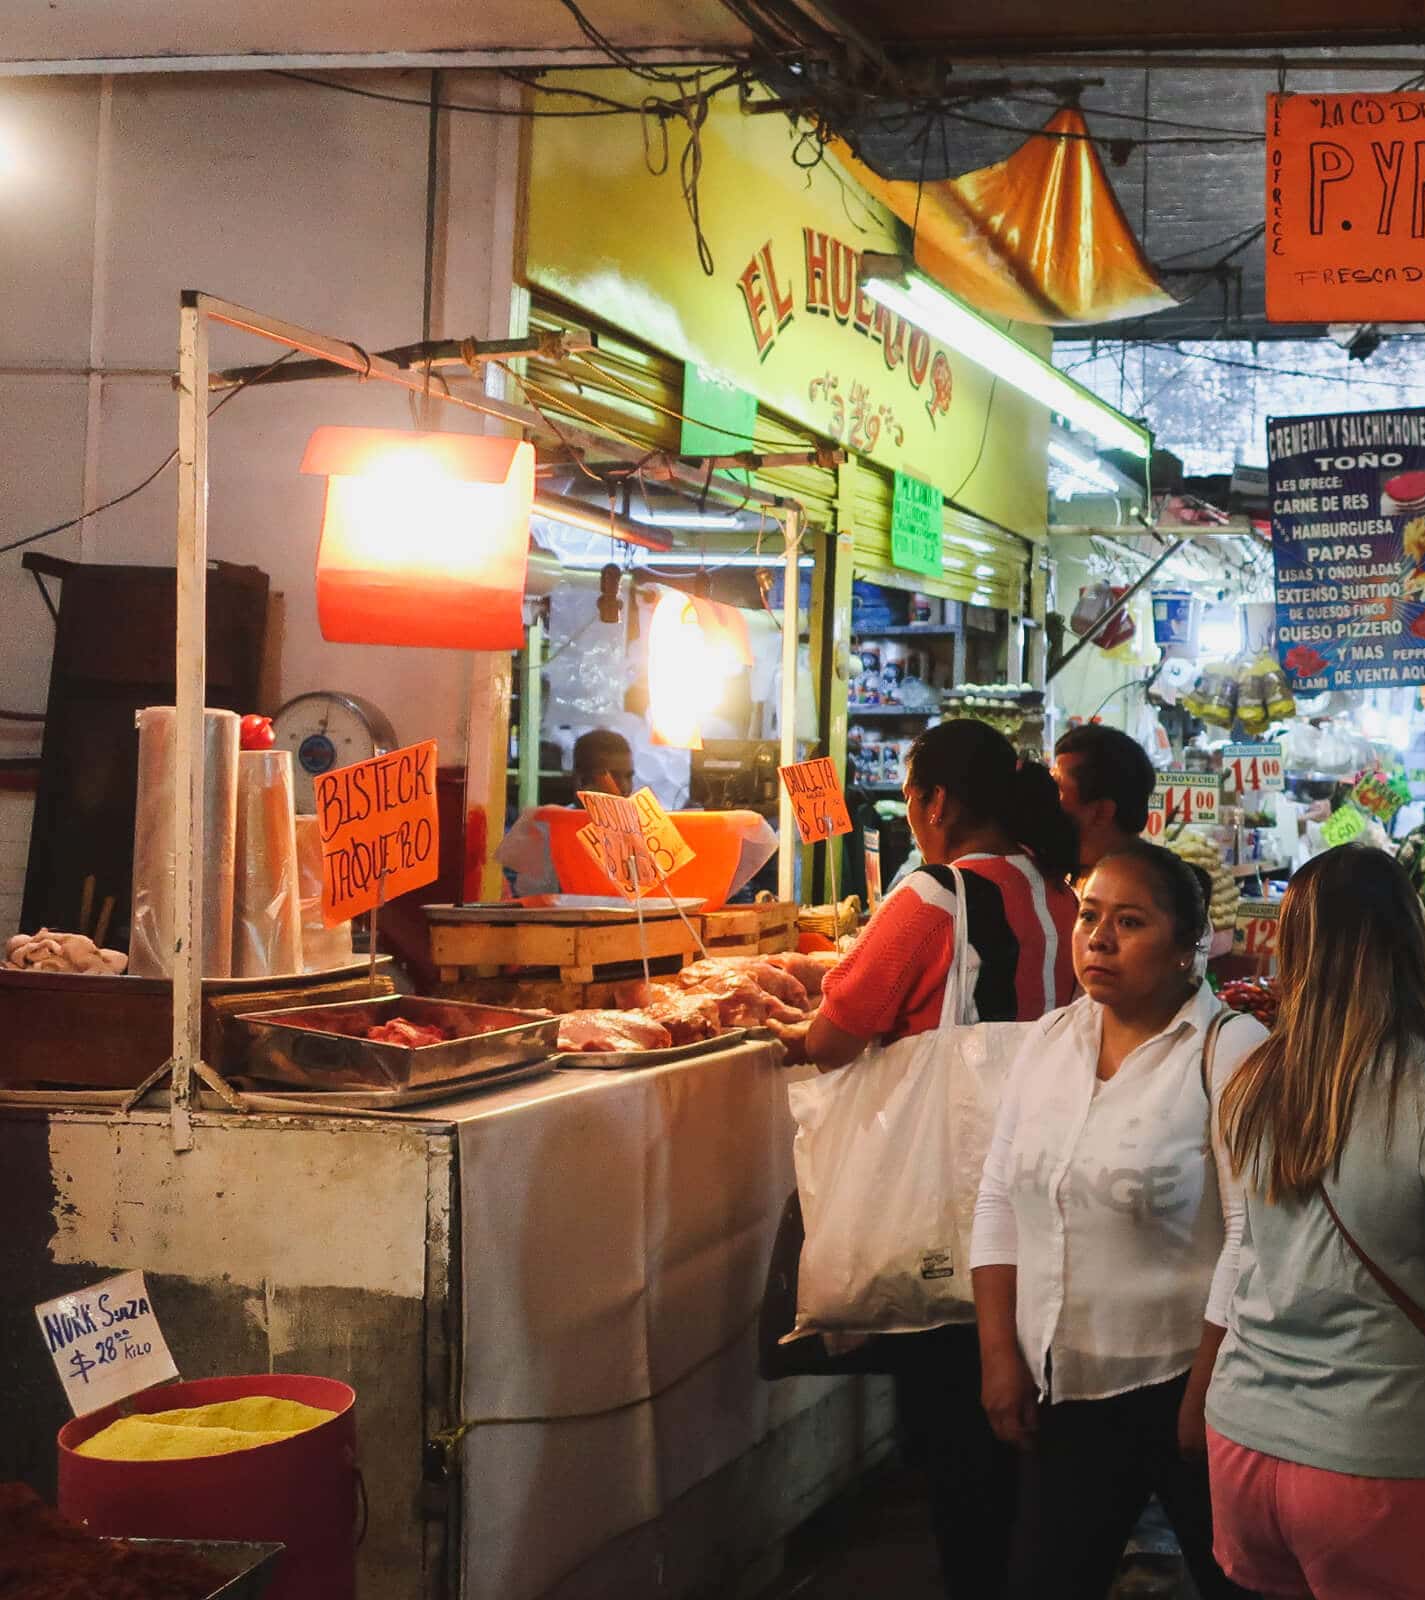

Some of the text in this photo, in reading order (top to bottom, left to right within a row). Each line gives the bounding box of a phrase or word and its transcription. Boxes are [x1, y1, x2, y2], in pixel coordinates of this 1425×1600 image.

[1295, 266, 1398, 286] FRESCA
[736, 239, 795, 366] EL
[1269, 419, 1329, 462] CREMERIA
[1329, 418, 1339, 448] Y
[1314, 452, 1403, 472] TOÑO
[1276, 478, 1297, 492] LES
[1274, 493, 1369, 514] CARNE DE RES
[1292, 519, 1395, 540] HAMBURGUESA
[1307, 543, 1373, 562] PAPAS
[1279, 562, 1401, 582] LISAS Y ONDULADAS
[1277, 582, 1400, 604] EXTENSO SURTIDO
[1289, 602, 1386, 620] DE QUESOS FINOS
[1279, 620, 1403, 642] QUESO PIZZERO
[1337, 648, 1347, 661] Y
[1352, 645, 1385, 660] MAS
[1335, 670, 1352, 685] DE
[1355, 667, 1398, 683] VENTA
[1231, 757, 1261, 793] 14
[318, 748, 432, 843] BISTECK
[1165, 786, 1193, 823] 14
[1196, 790, 1214, 810] 00
[326, 818, 432, 907] TAQUERO
[69, 1350, 97, 1384] $
